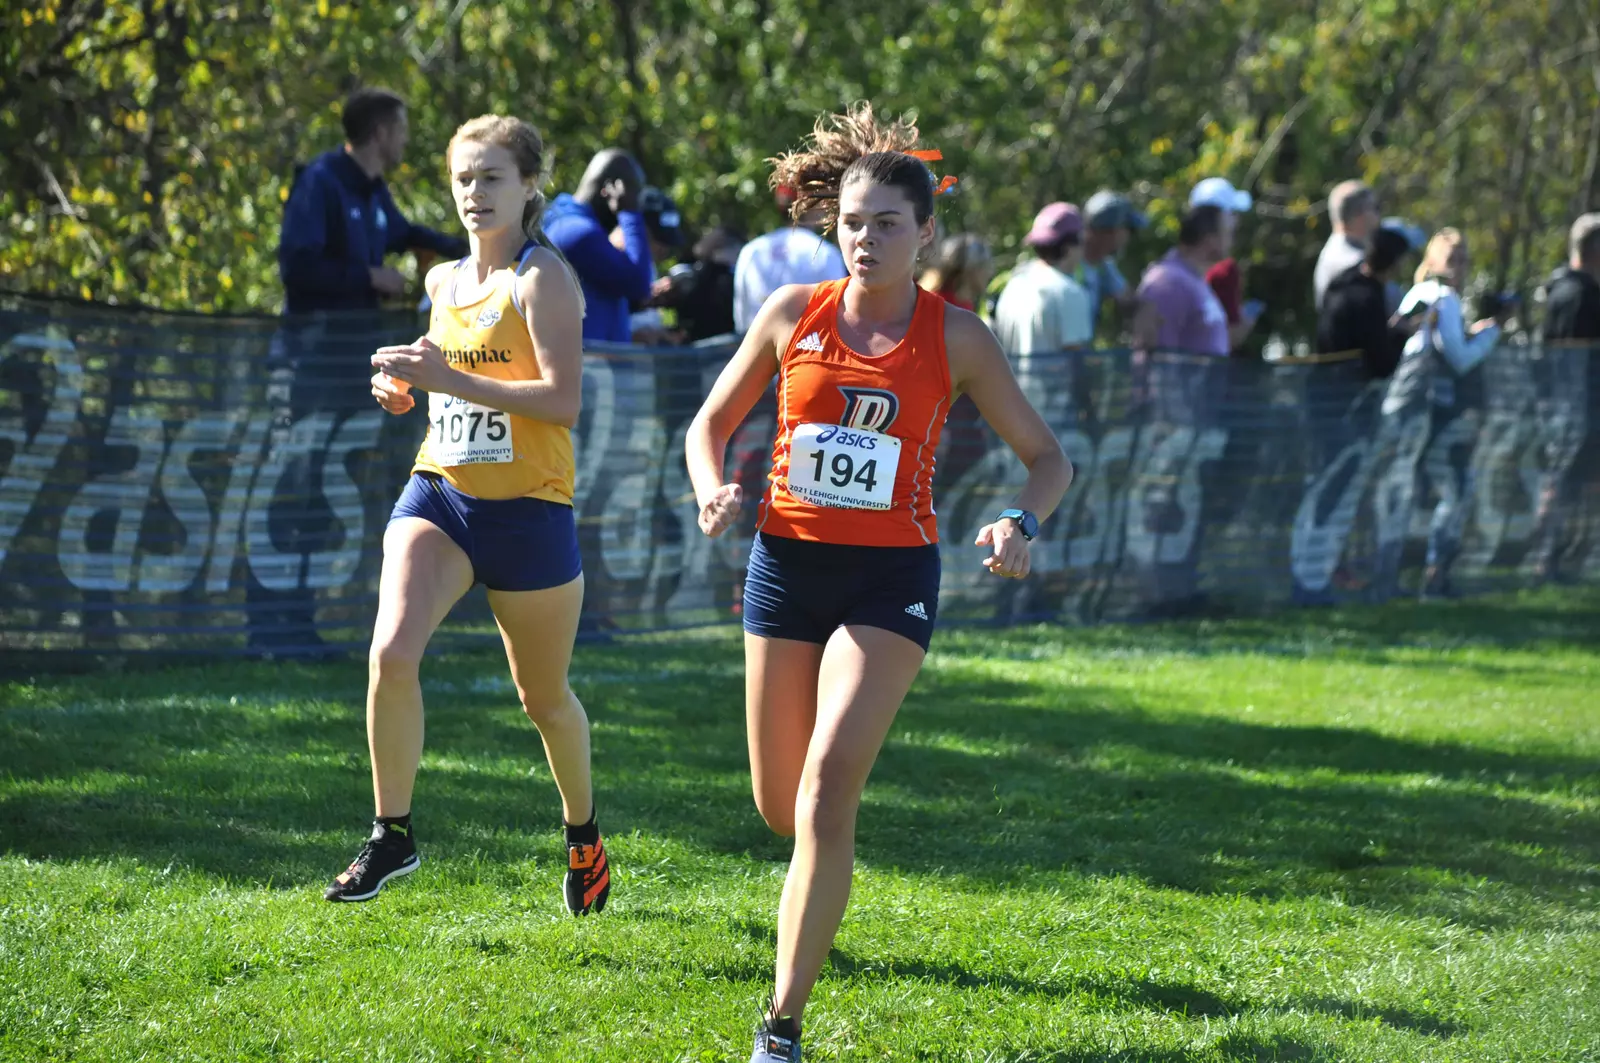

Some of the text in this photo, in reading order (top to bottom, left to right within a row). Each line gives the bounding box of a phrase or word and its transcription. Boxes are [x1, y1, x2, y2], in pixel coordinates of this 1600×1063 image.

[436, 411, 507, 443] 1075
[467, 447, 512, 456] UNIVERSITY
[457, 456, 480, 464] SHORT
[810, 449, 877, 492] 194
[789, 484, 890, 509] 2021 LEHIGH UNIVERSITY
[803, 495, 823, 507] PAUL
[904, 606, 928, 621] adidas
